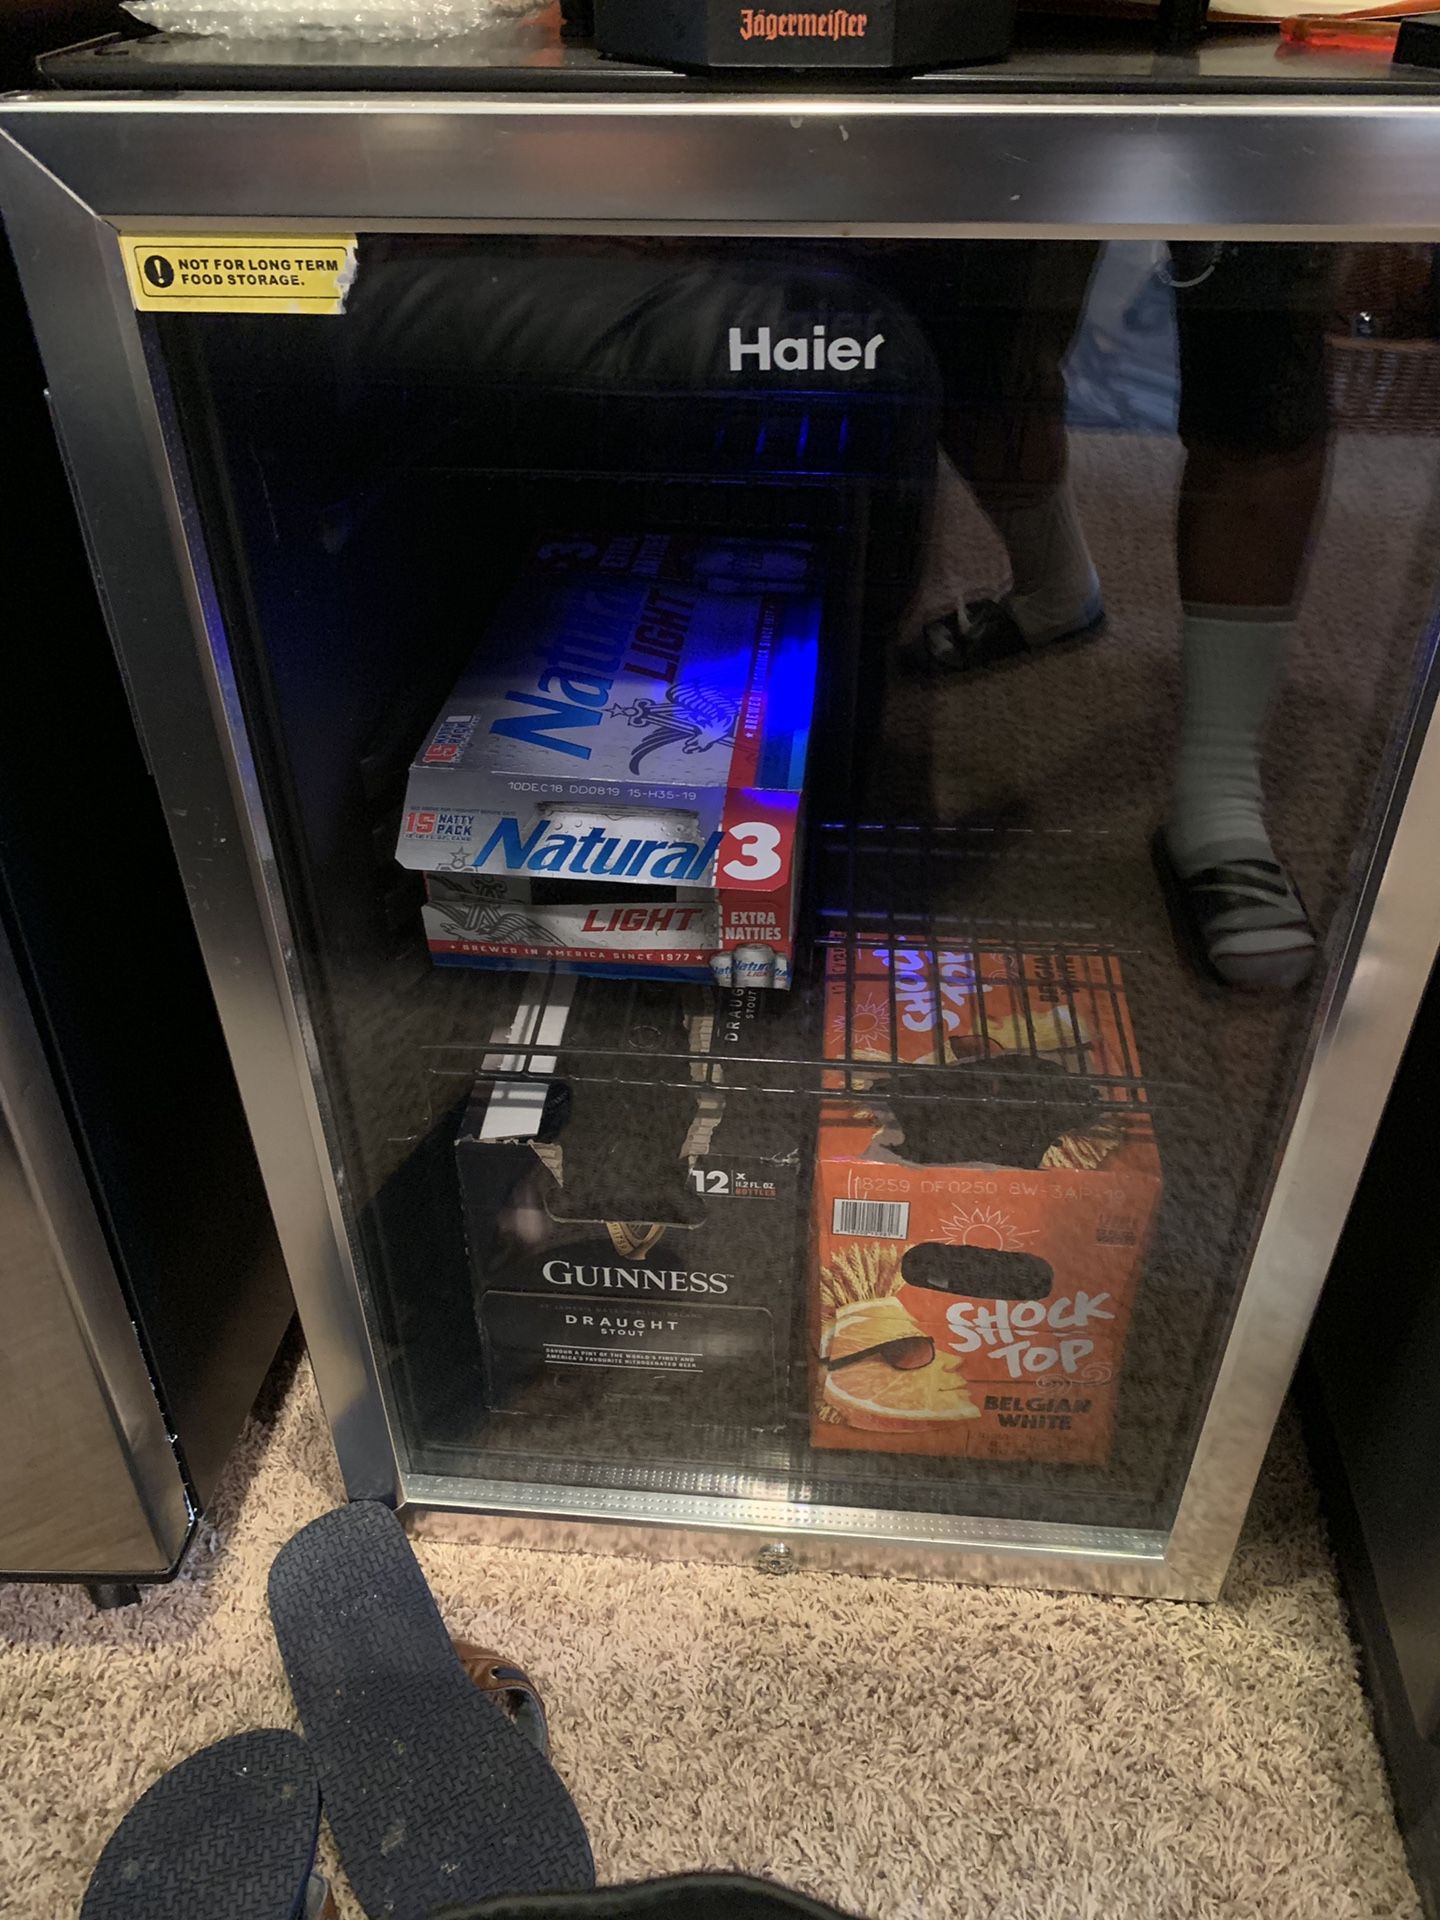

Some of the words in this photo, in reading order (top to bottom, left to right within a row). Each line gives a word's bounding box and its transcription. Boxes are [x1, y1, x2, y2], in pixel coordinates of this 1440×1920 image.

[739, 9, 867, 41] Jägermeister
[178, 258, 210, 270] NOT
[214, 259, 244, 271] FOR
[248, 259, 291, 271] LONG
[295, 259, 338, 271] TERM
[182, 274, 223, 285] FOOD
[228, 274, 305, 286] STORAGE.
[729, 325, 885, 371] Haier
[508, 781, 563, 793] 10DEC18
[627, 788, 697, 800] 15-H35-19
[406, 812, 436, 834] 15
[438, 814, 475, 825] NATTY
[436, 825, 472, 836] PACK
[474, 817, 724, 881] Natural
[722, 821, 781, 881] 3
[580, 908, 703, 933] LIGHT
[731, 911, 776, 926] EXTRA
[725, 927, 782, 941] NATTIES
[462, 944, 518, 955] BREWED
[524, 947, 539, 955] IN
[546, 949, 605, 959] AMERICA
[613, 951, 653, 961] SINCE
[660, 952, 690, 962] 1977
[745, 991, 757, 1019] STOUT
[723, 988, 744, 1042] DRAUG
[692, 1169, 729, 1194] 12
[735, 1187, 776, 1196] BOTTLES
[542, 1259, 729, 1294] GUINNESS
[565, 1314, 679, 1331] DRAUGHT
[945, 1290, 1115, 1353] SHOCK
[600, 1328, 645, 1337] STOUT
[585, 1356, 623, 1364] FAVOURITE
[988, 1337, 1095, 1379] TOP
[984, 1395, 1092, 1414] BELGIAN
[997, 1413, 1072, 1431] WHITE
